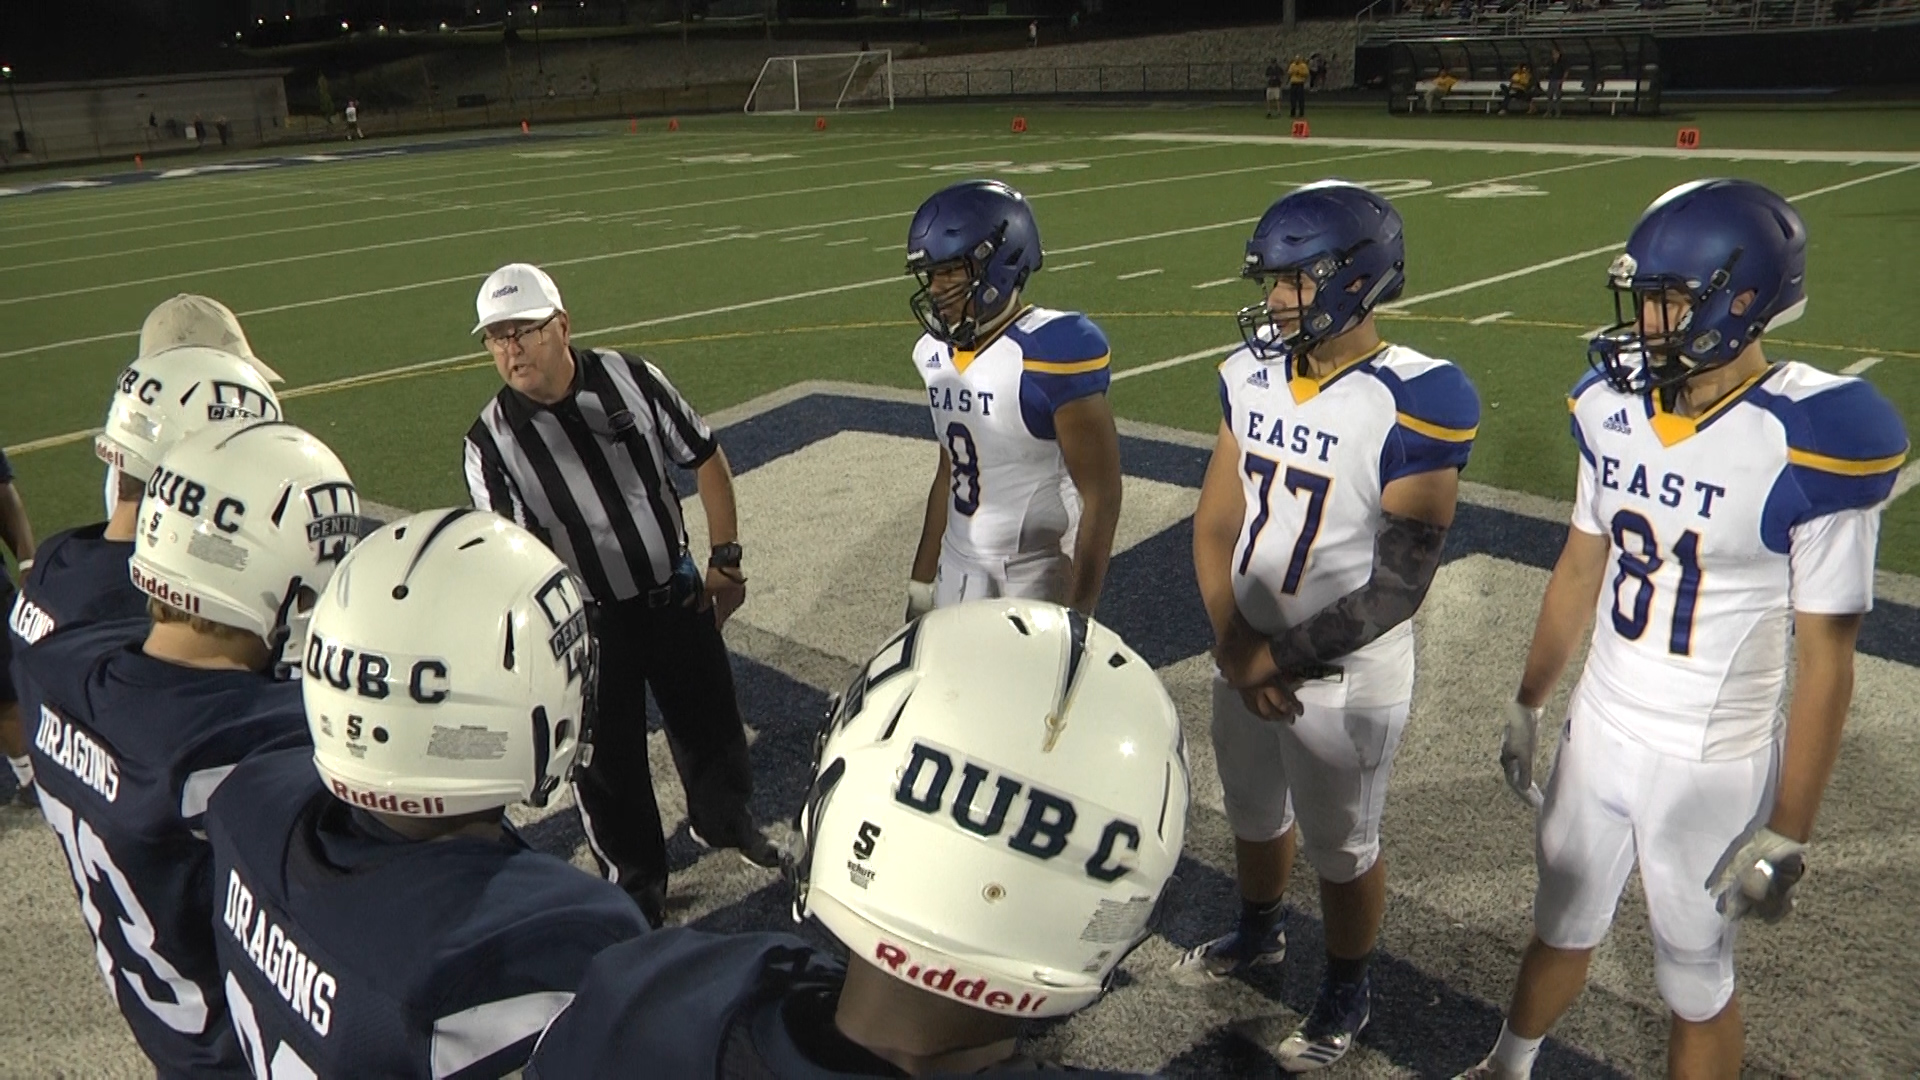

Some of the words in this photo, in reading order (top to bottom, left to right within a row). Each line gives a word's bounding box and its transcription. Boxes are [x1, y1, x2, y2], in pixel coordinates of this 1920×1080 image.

[1679, 130, 1696, 146] 40
[139, 378, 163, 406] C
[928, 387, 994, 416] EAST
[946, 421, 980, 518] 8
[1247, 411, 1339, 462] EAST
[147, 465, 206, 518] DUB
[213, 497, 246, 534] C
[1602, 456, 1725, 519] EAST
[1238, 451, 1335, 597] 77
[132, 565, 200, 614] Riddell
[1611, 509, 1702, 657] 81
[305, 633, 391, 700] DUB
[409, 660, 448, 705] C
[34, 702, 121, 803] DRAGONS
[331, 779, 445, 815] Riddell
[894, 742, 1079, 861] DUB
[1085, 818, 1141, 883] C
[223, 867, 337, 1038] DRAGONS
[875, 941, 1048, 1013] Riddell
